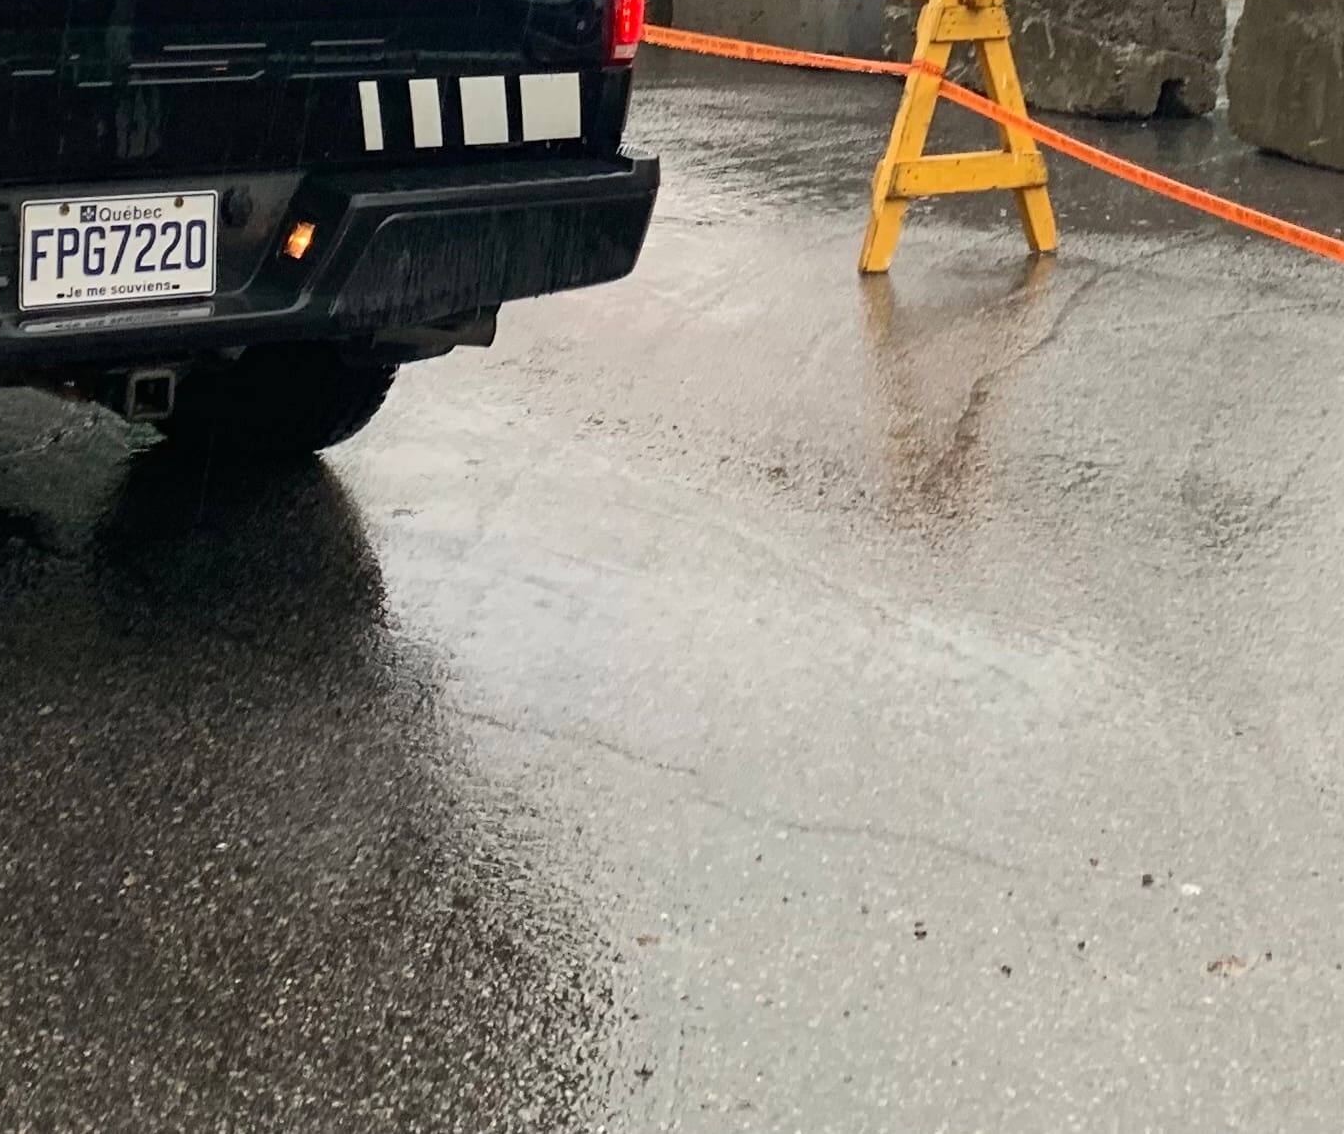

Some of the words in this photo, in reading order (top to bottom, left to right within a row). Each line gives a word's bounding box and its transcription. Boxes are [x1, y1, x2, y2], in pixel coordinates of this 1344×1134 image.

[99, 205, 162, 221] Québec
[30, 219, 207, 281] FPG7220
[67, 286, 82, 298] Je
[87, 285, 106, 297] me
[111, 281, 171, 295] souviens
